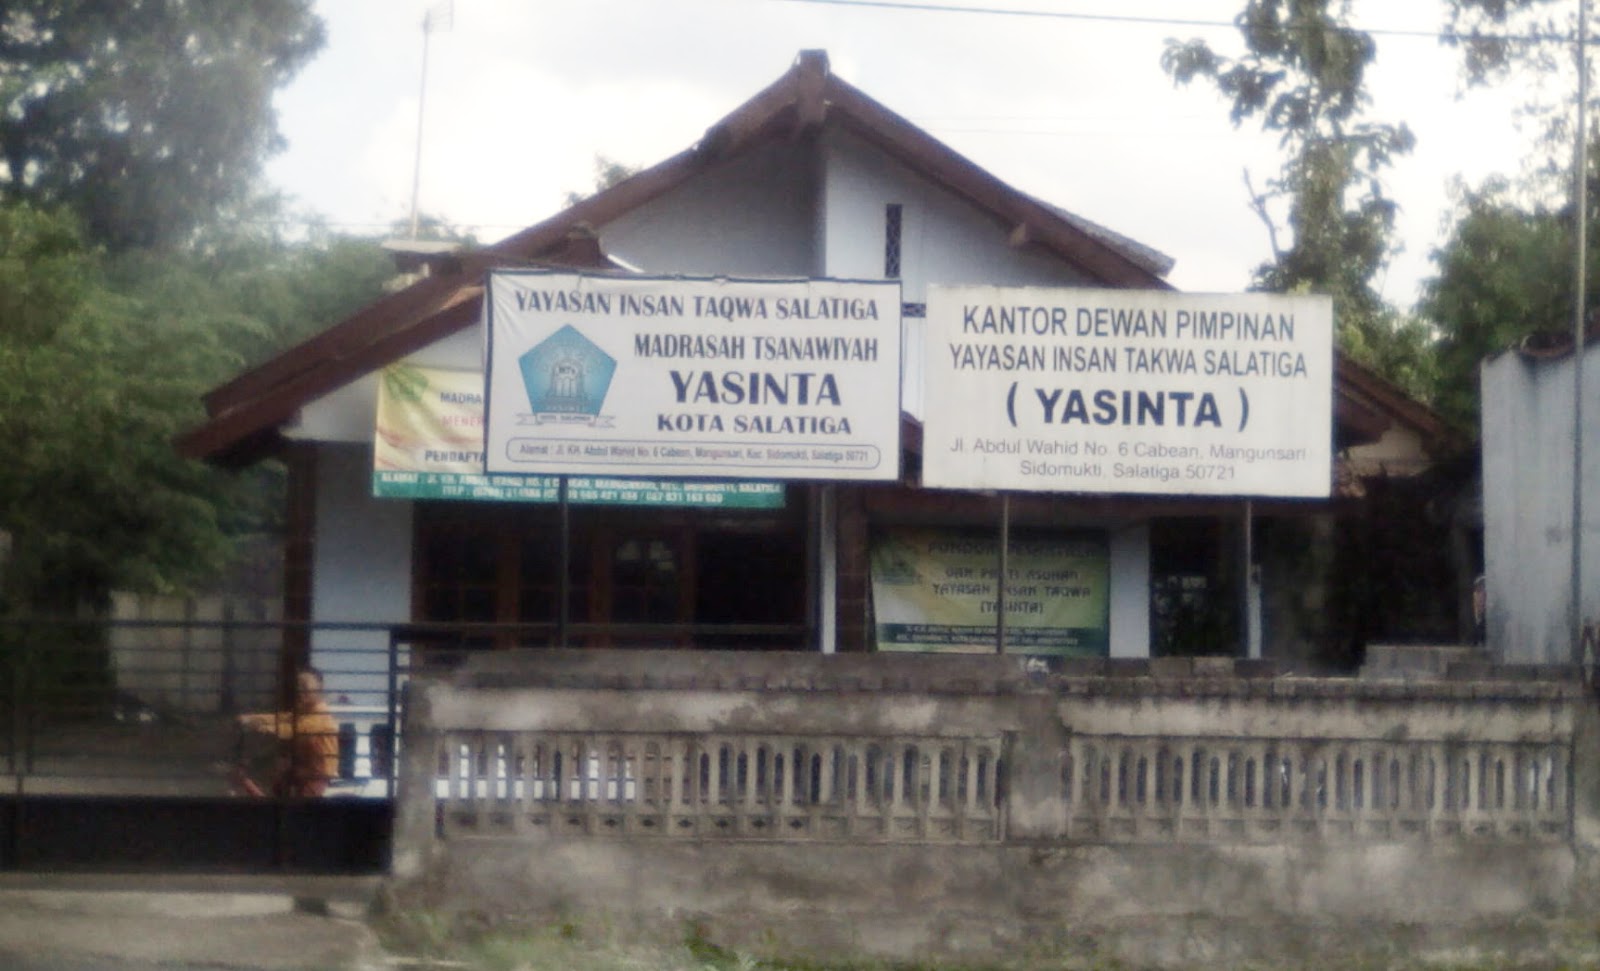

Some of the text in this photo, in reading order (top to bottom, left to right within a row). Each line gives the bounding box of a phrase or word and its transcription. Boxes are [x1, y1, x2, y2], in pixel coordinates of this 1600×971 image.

[515, 290, 879, 321] YAYASAN INSAN TAQWA SALATIGA
[963, 305, 1294, 341] KANTOR DEWAN PIMPINAN
[634, 334, 878, 362] MADRASAH TSANAWIYAH
[950, 343, 1307, 378] YAYASAN INSAN TAKWA SALATIGA
[669, 370, 842, 406] YASINTA
[1035, 388, 1222, 428] YASINTA
[657, 414, 852, 435] KOTA SALATIGA
[973, 438, 1021, 454] Abdul
[1027, 439, 1077, 455] Wahid
[1118, 441, 1129, 456] 6
[1113, 463, 1180, 481] Salatiga
[1185, 465, 1235, 480] 50721
